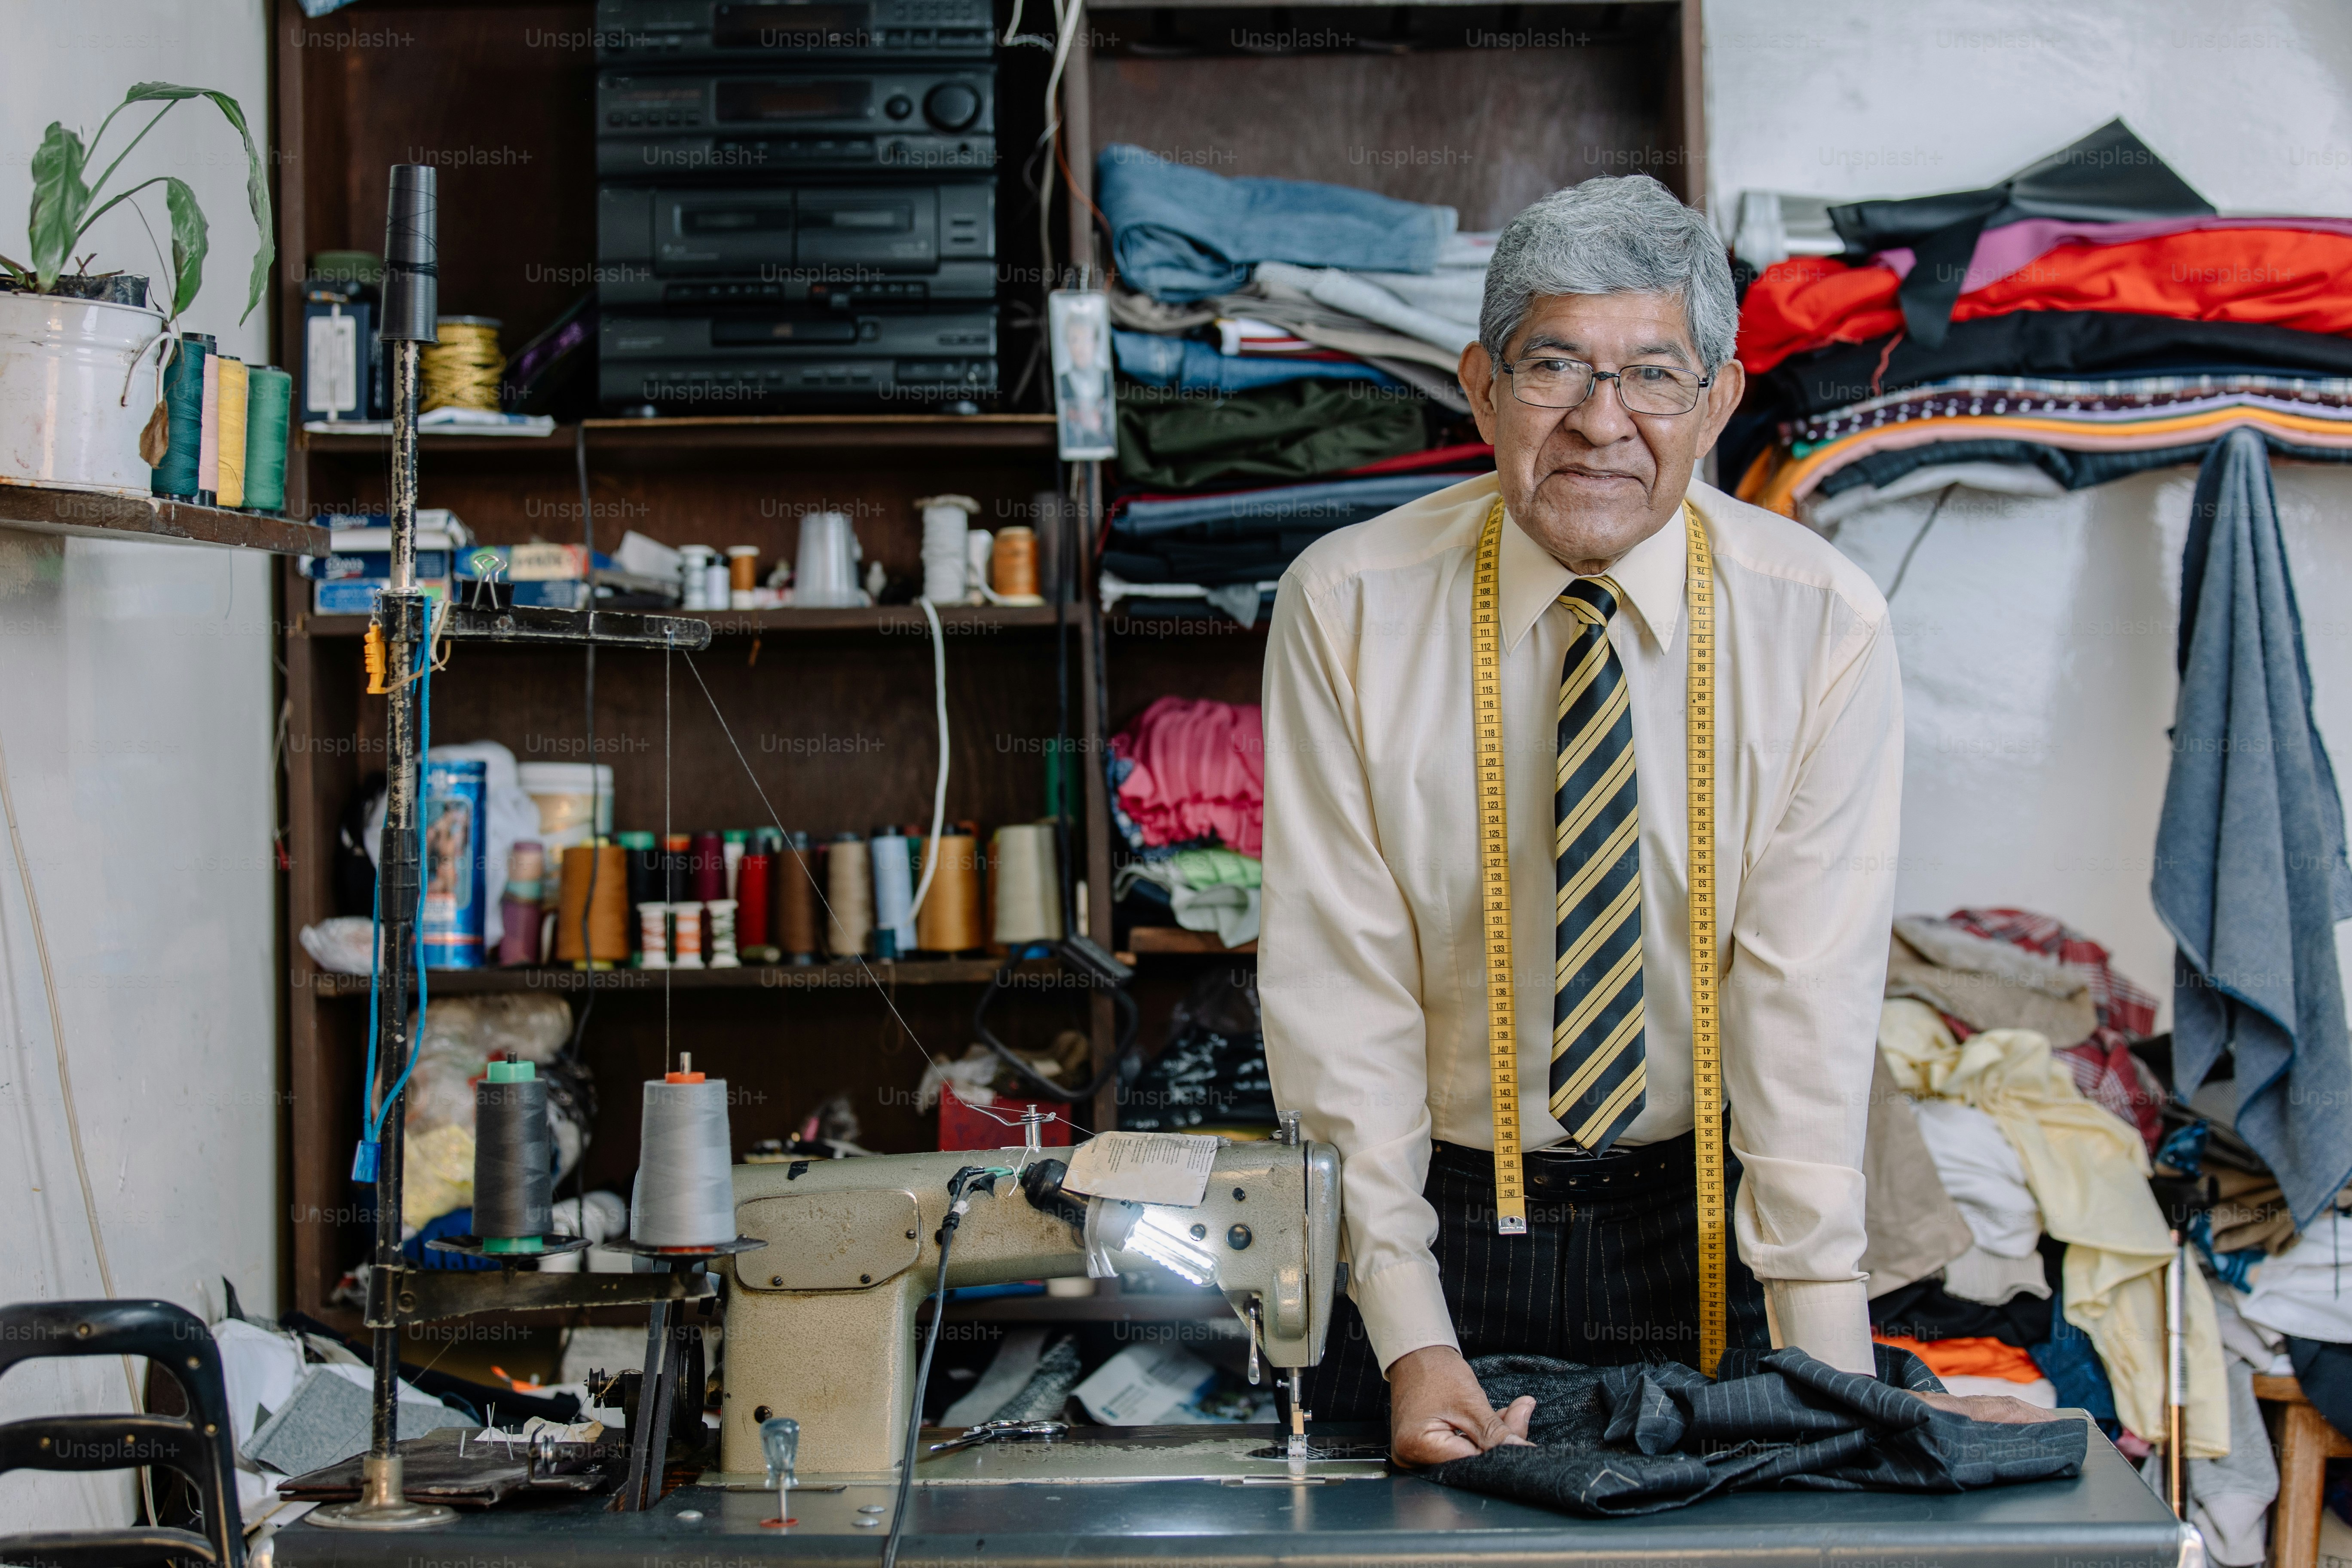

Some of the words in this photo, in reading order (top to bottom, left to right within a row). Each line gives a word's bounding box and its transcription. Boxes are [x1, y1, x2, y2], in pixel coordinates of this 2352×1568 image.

[1481, 657, 1491, 665] 113
[1482, 686, 1493, 694] 115
[1483, 714, 1494, 723] 117
[1488, 815, 1499, 823] 124
[1489, 844, 1500, 852] 126
[1491, 901, 1502, 910] 130
[1494, 959, 1505, 967] 134
[1504, 1189, 1515, 1197] 150
